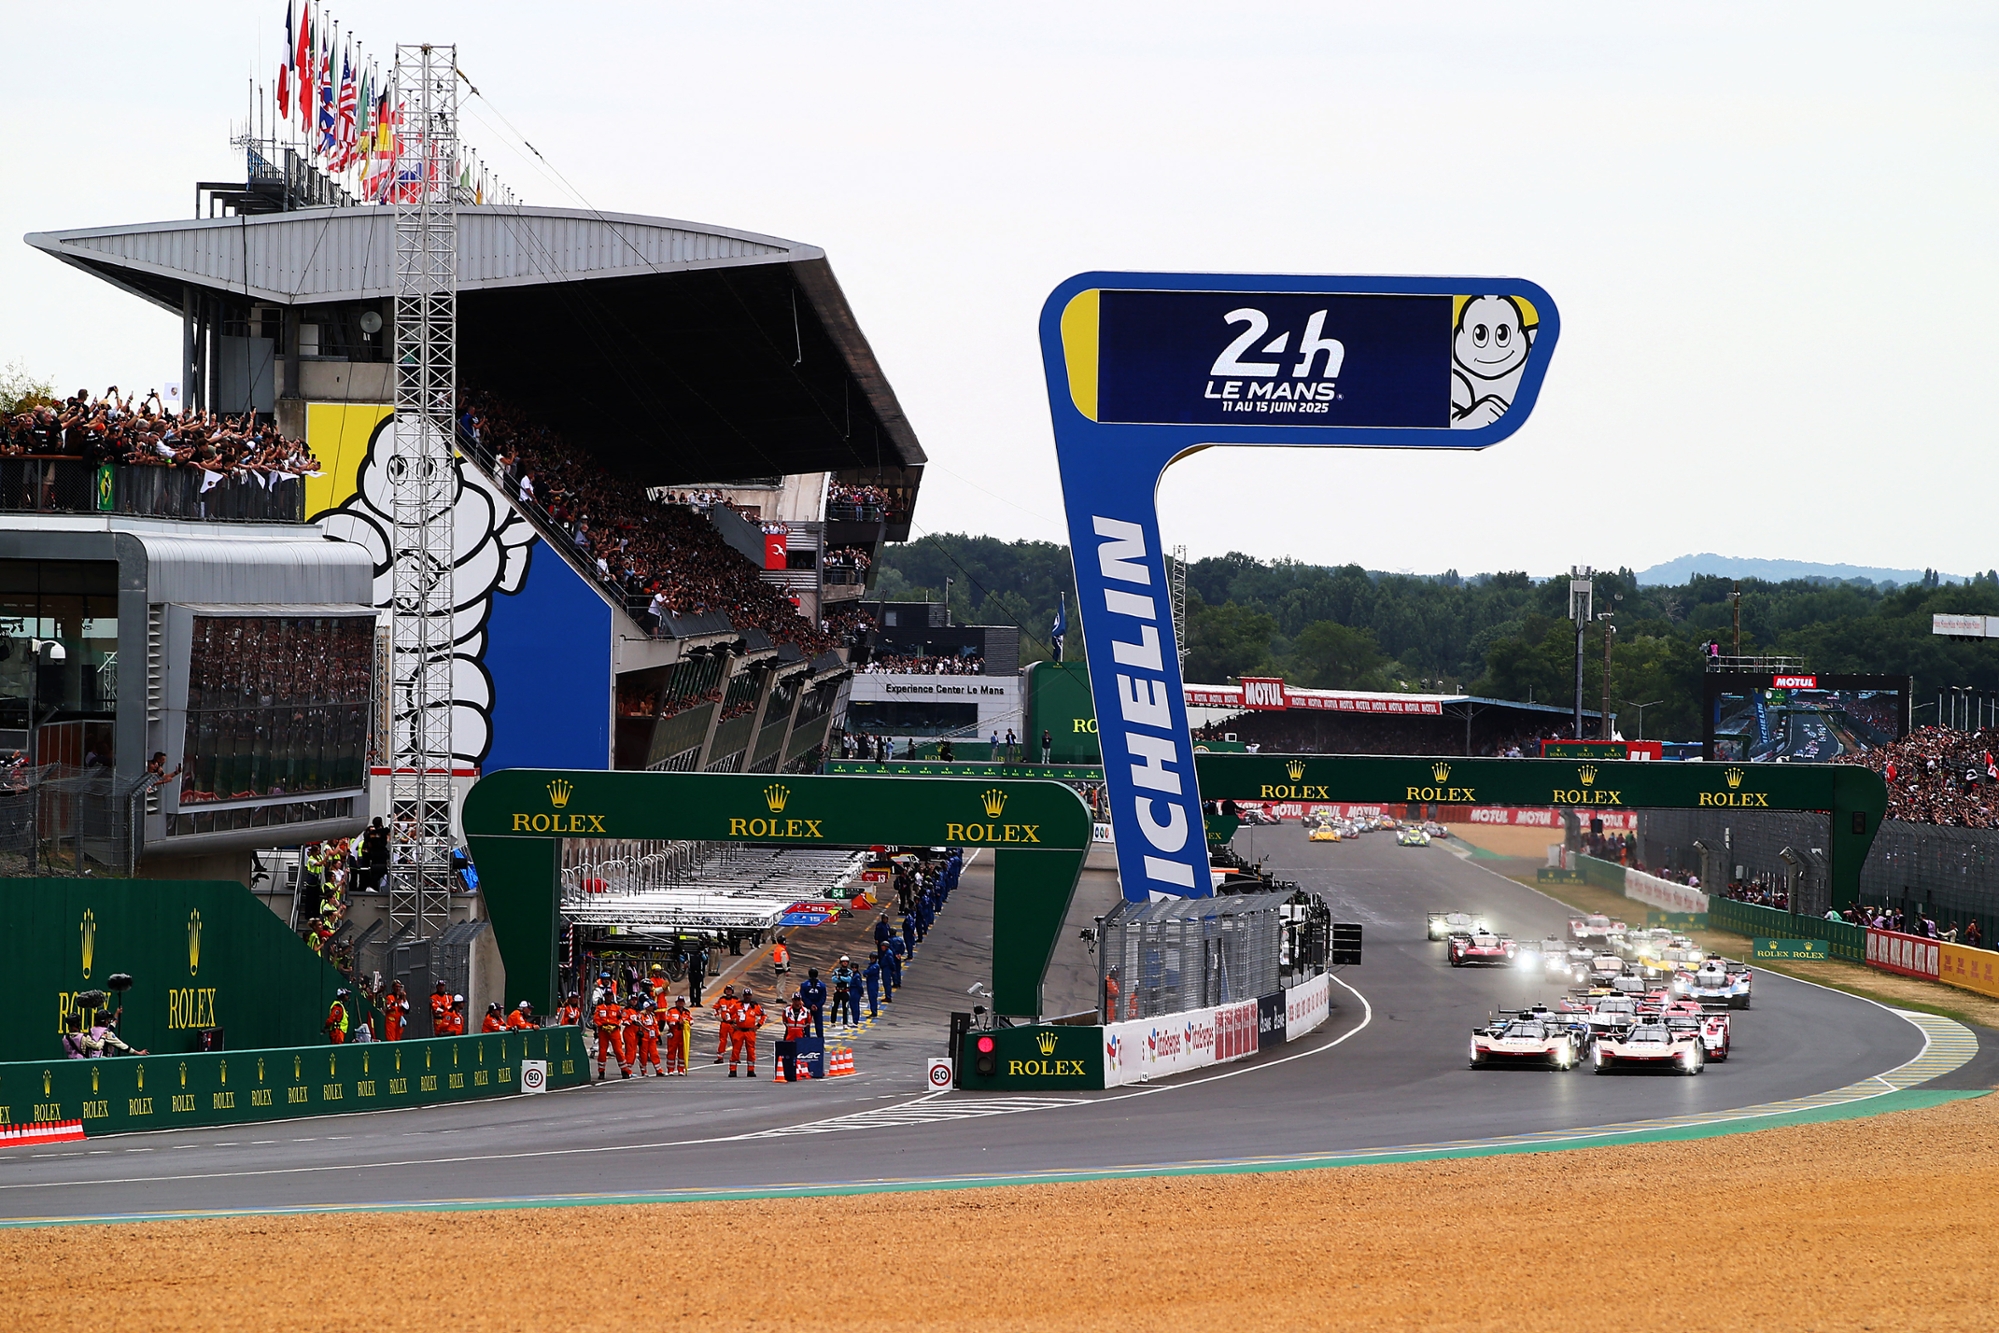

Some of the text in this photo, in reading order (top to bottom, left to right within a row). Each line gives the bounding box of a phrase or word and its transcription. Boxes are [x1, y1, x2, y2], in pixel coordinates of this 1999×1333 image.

[1210, 307, 1345, 379] 24h
[1204, 381, 1336, 401] LE MANS
[1222, 401, 1329, 414] 11 AU 15 JUIN 2025
[886, 684, 1004, 695] Experience Center Le Mans
[1776, 678, 1813, 686] MOTUL
[1245, 682, 1284, 706] MOTUL
[1092, 515, 1195, 902] ICHELIN
[1260, 785, 1768, 807] ROLEX ROLEX ROLEX ROLEX
[1272, 804, 1302, 817] MOTUL
[1471, 809, 1508, 823] MOTUL
[1515, 811, 1551, 825] MOTUL
[511, 813, 1041, 843] ROLEX ROLEX ROLEX
[833, 889, 843, 897] 54
[1757, 950, 1825, 959] ROLEX ROLEX
[168, 987, 216, 1030] ROLEX
[528, 1072, 539, 1081] 60
[934, 1071, 947, 1080] 60
[1008, 1060, 1086, 1076] ROLEX
[33, 1103, 61, 1122] ROLEX
[82, 1100, 109, 1119] ROLEX
[128, 1097, 153, 1116] ROLEX
[172, 1094, 195, 1112] ROLEX
[213, 1091, 235, 1109] ROLEX
[251, 1089, 272, 1106] ROLEX
[288, 1086, 308, 1103] ROLEX
